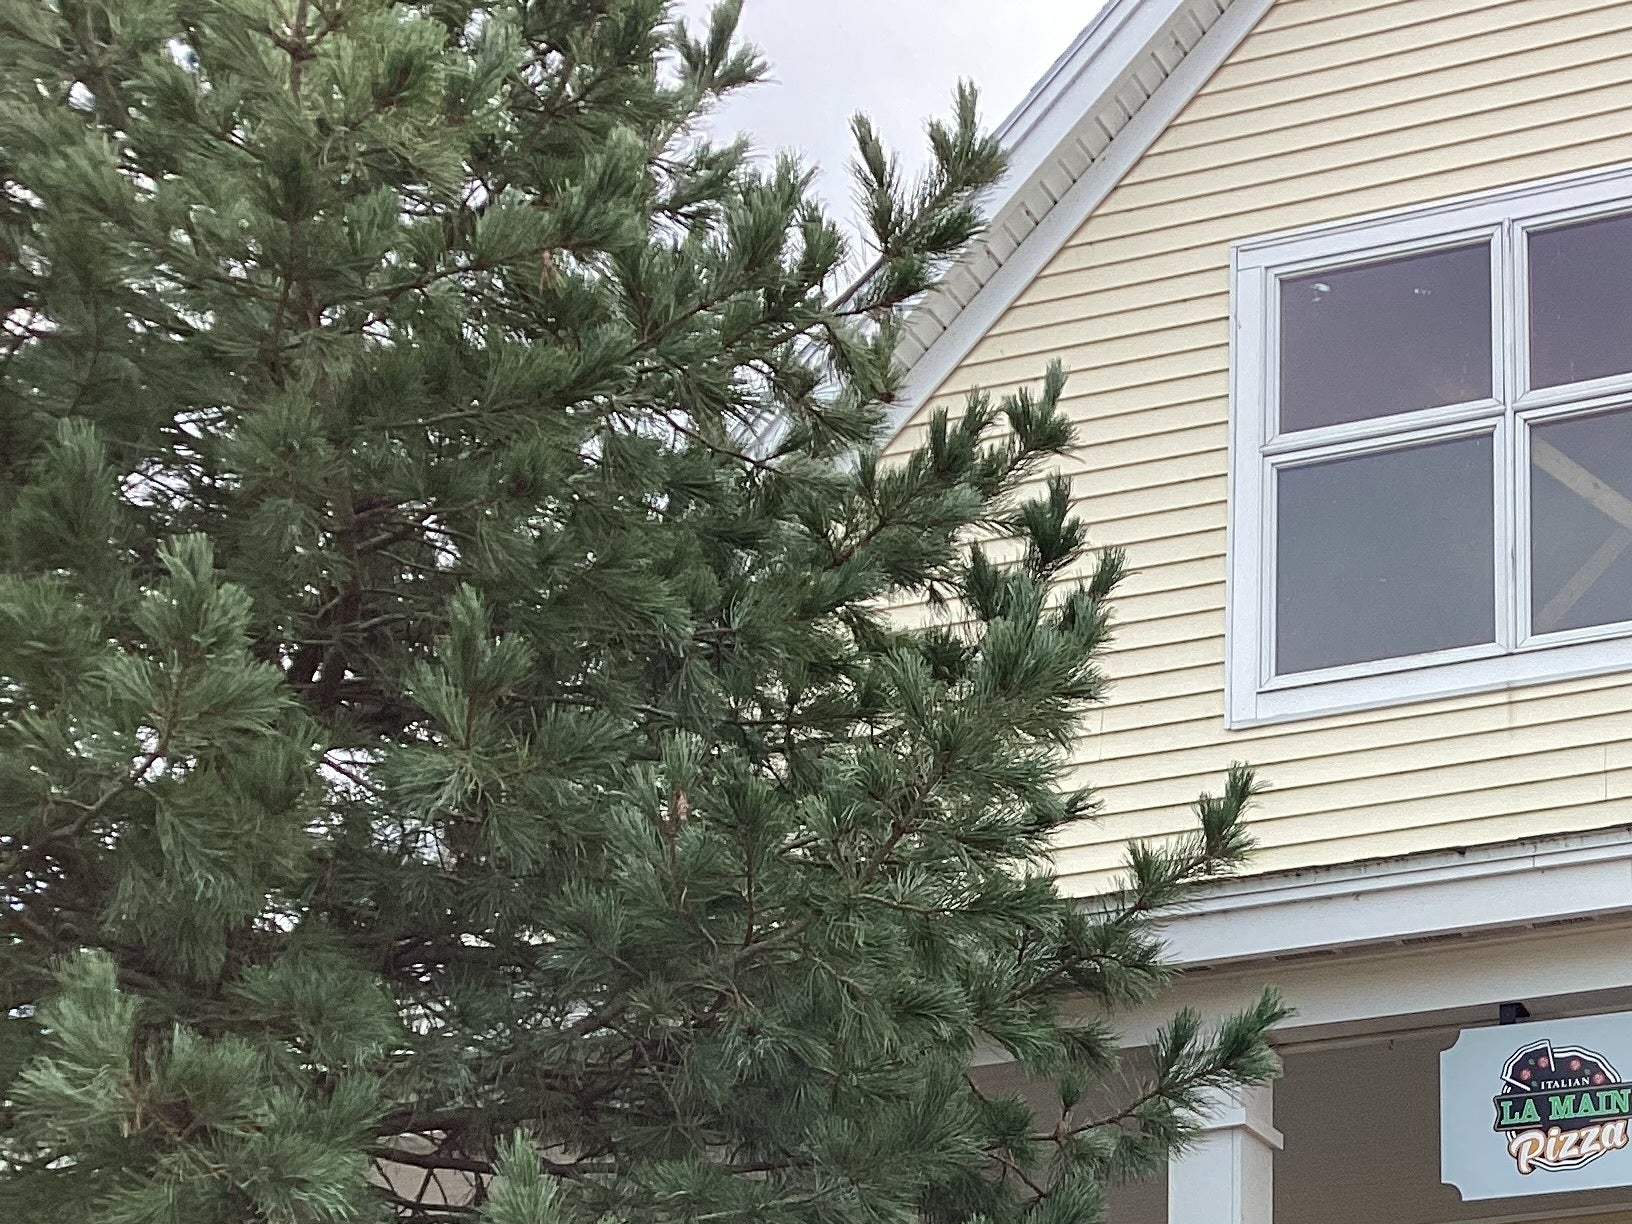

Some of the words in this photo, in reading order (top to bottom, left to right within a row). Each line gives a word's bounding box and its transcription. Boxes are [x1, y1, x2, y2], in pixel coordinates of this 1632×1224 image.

[1540, 1076, 1590, 1090] ITALIAN
[1500, 1098, 1541, 1126] LA
[1548, 1088, 1632, 1121] MAIN
[1508, 1119, 1628, 1175] Pizza
